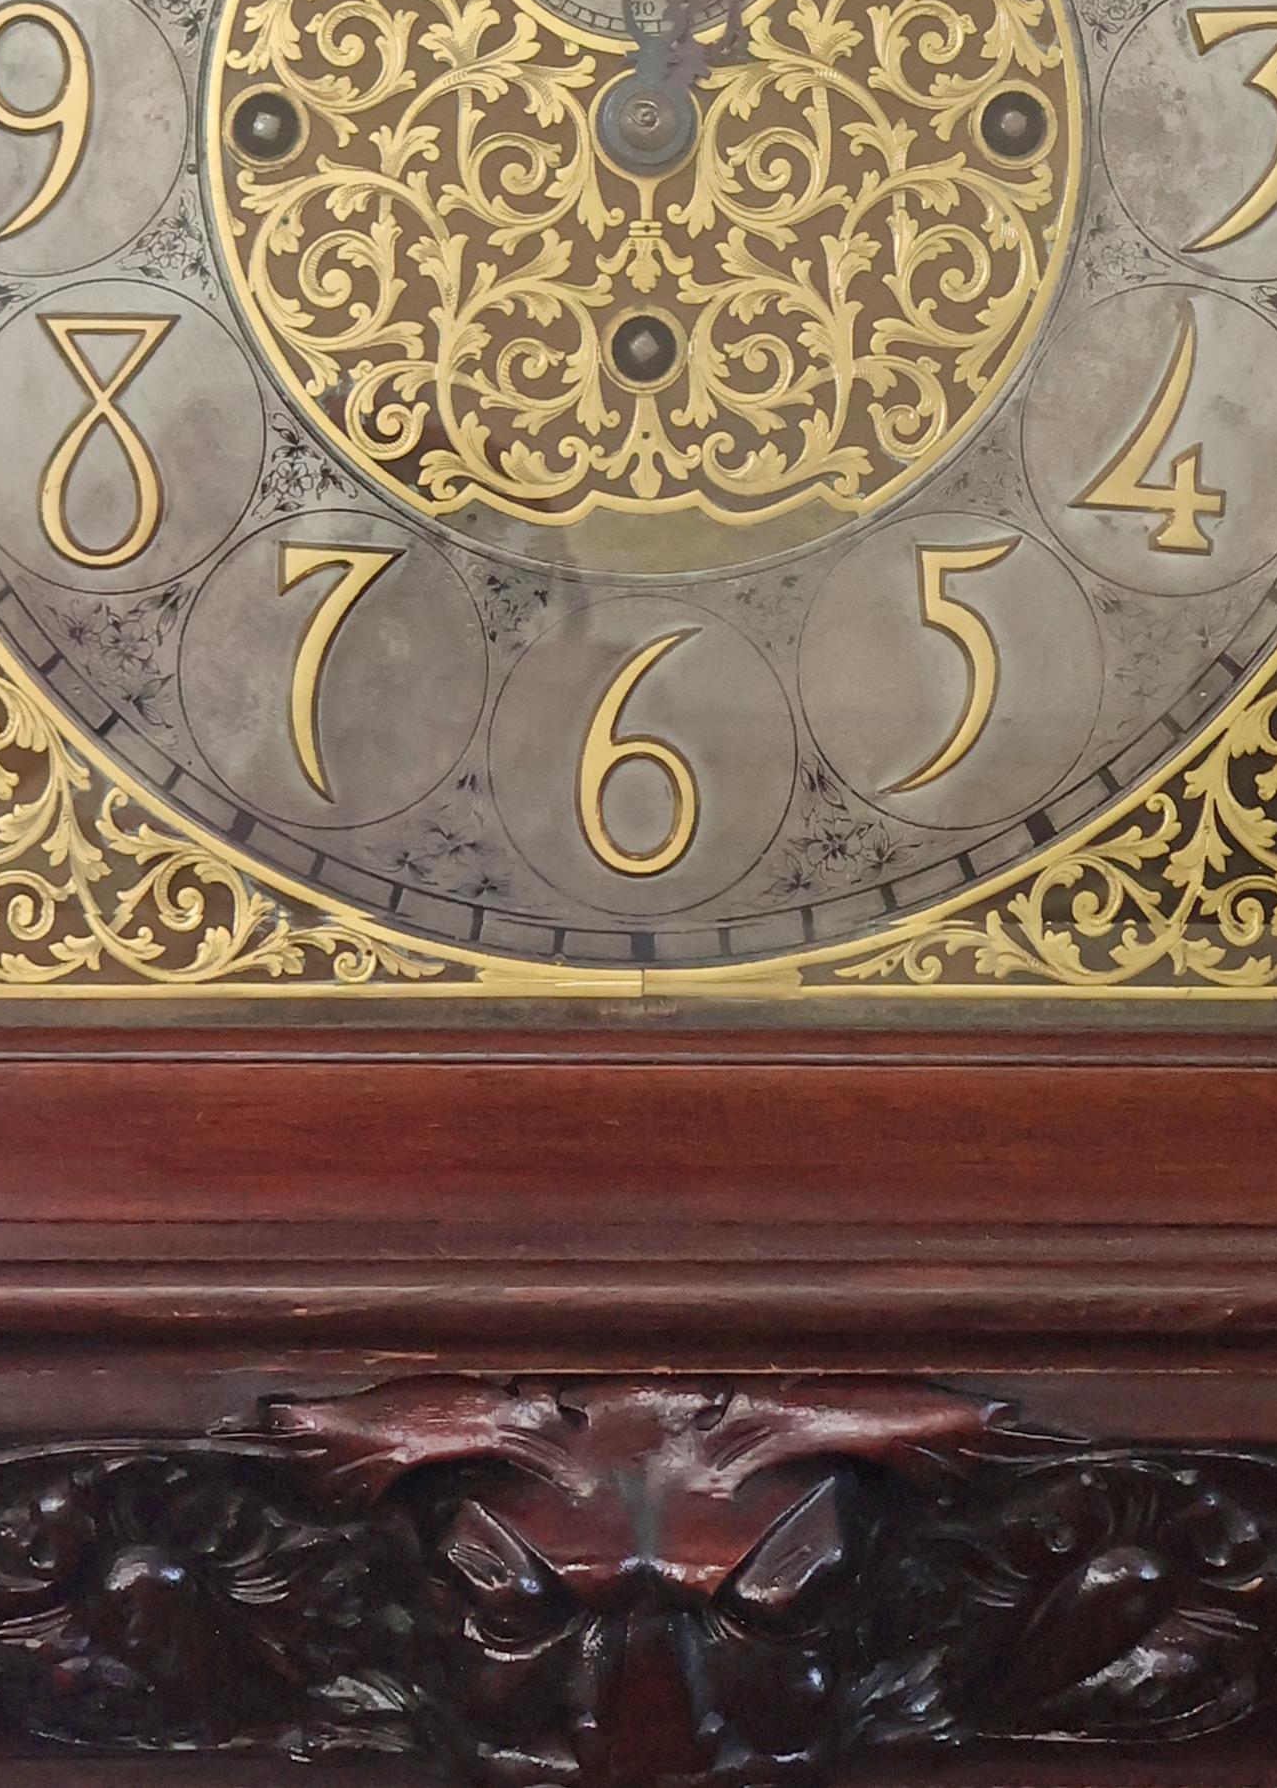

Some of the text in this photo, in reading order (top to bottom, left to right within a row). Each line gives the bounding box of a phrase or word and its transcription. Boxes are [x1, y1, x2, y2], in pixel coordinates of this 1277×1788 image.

[35, 312, 181, 570] 8
[1068, 300, 1227, 557] 4
[278, 539, 407, 804] 7
[573, 626, 703, 878] 6
[876, 534, 1023, 797] 5
